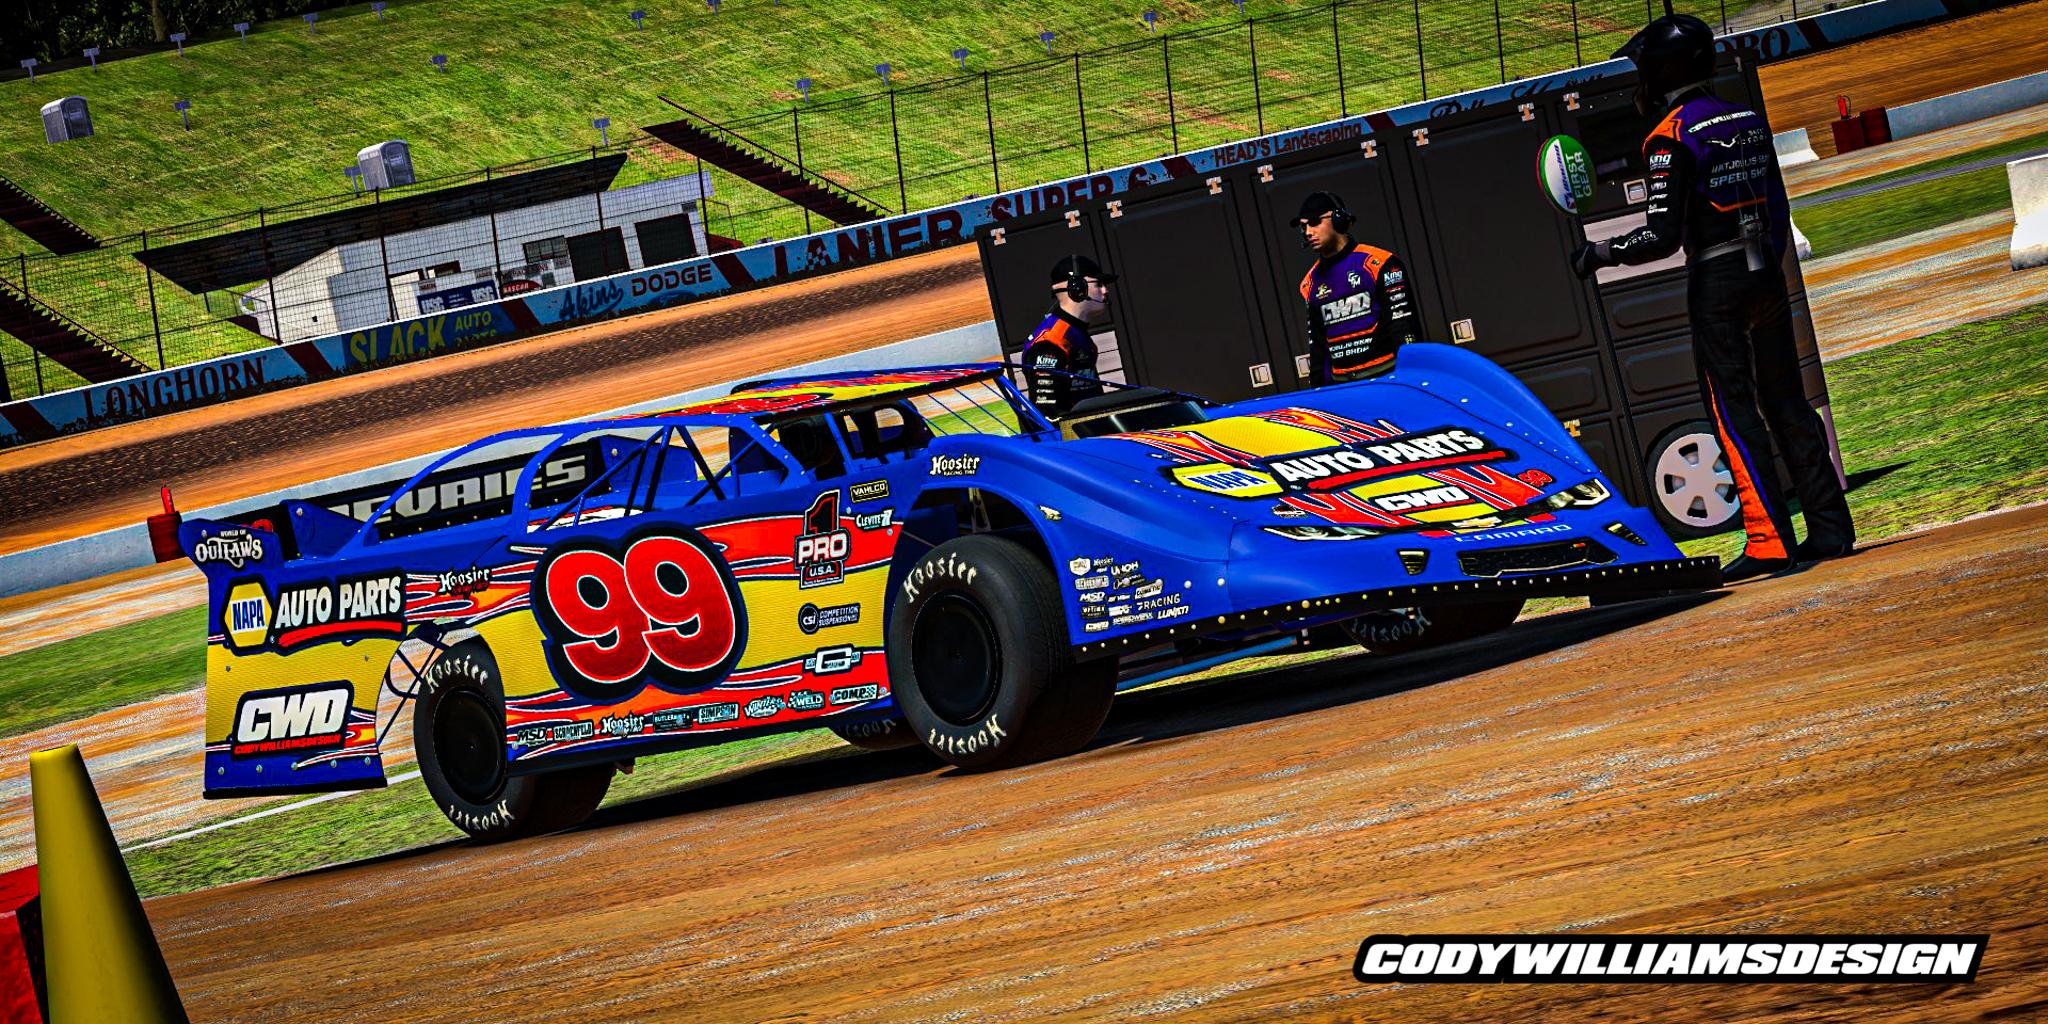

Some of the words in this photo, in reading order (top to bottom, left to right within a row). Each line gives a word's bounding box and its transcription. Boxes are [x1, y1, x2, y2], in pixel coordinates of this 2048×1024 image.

[1565, 153, 1583, 198] FIRST
[1574, 151, 1592, 197] GEAR
[632, 264, 712, 297] DODGE
[350, 315, 446, 362] SLACK
[455, 311, 492, 330] AUTO
[84, 356, 266, 420] LONGHORN
[929, 453, 980, 475] Hoosier
[1271, 451, 1366, 483] AUTO
[1369, 429, 1485, 465] PARTS
[853, 483, 886, 496] VAHLCO
[1187, 470, 1268, 491] NAPA
[1374, 486, 1470, 511] CWD
[220, 529, 239, 538] WORLD
[798, 533, 847, 564] PRO
[1455, 525, 1573, 542] CAMARO
[438, 566, 490, 593] Hoosier
[903, 552, 977, 603] Hoosier
[231, 598, 265, 631] NAPA
[275, 586, 333, 630] AUTO
[339, 576, 401, 620] PARTS
[546, 536, 736, 684] 99
[819, 605, 859, 619] COMPETITION
[1143, 594, 1180, 610] RACING
[426, 654, 489, 694] Hoosier
[237, 688, 349, 742] CWD
[796, 694, 822, 706] WELD
[517, 728, 546, 742] MSD
[601, 714, 644, 735] Hoosier
[929, 714, 1007, 754] Hoosier
[450, 800, 515, 830] Hoosier
